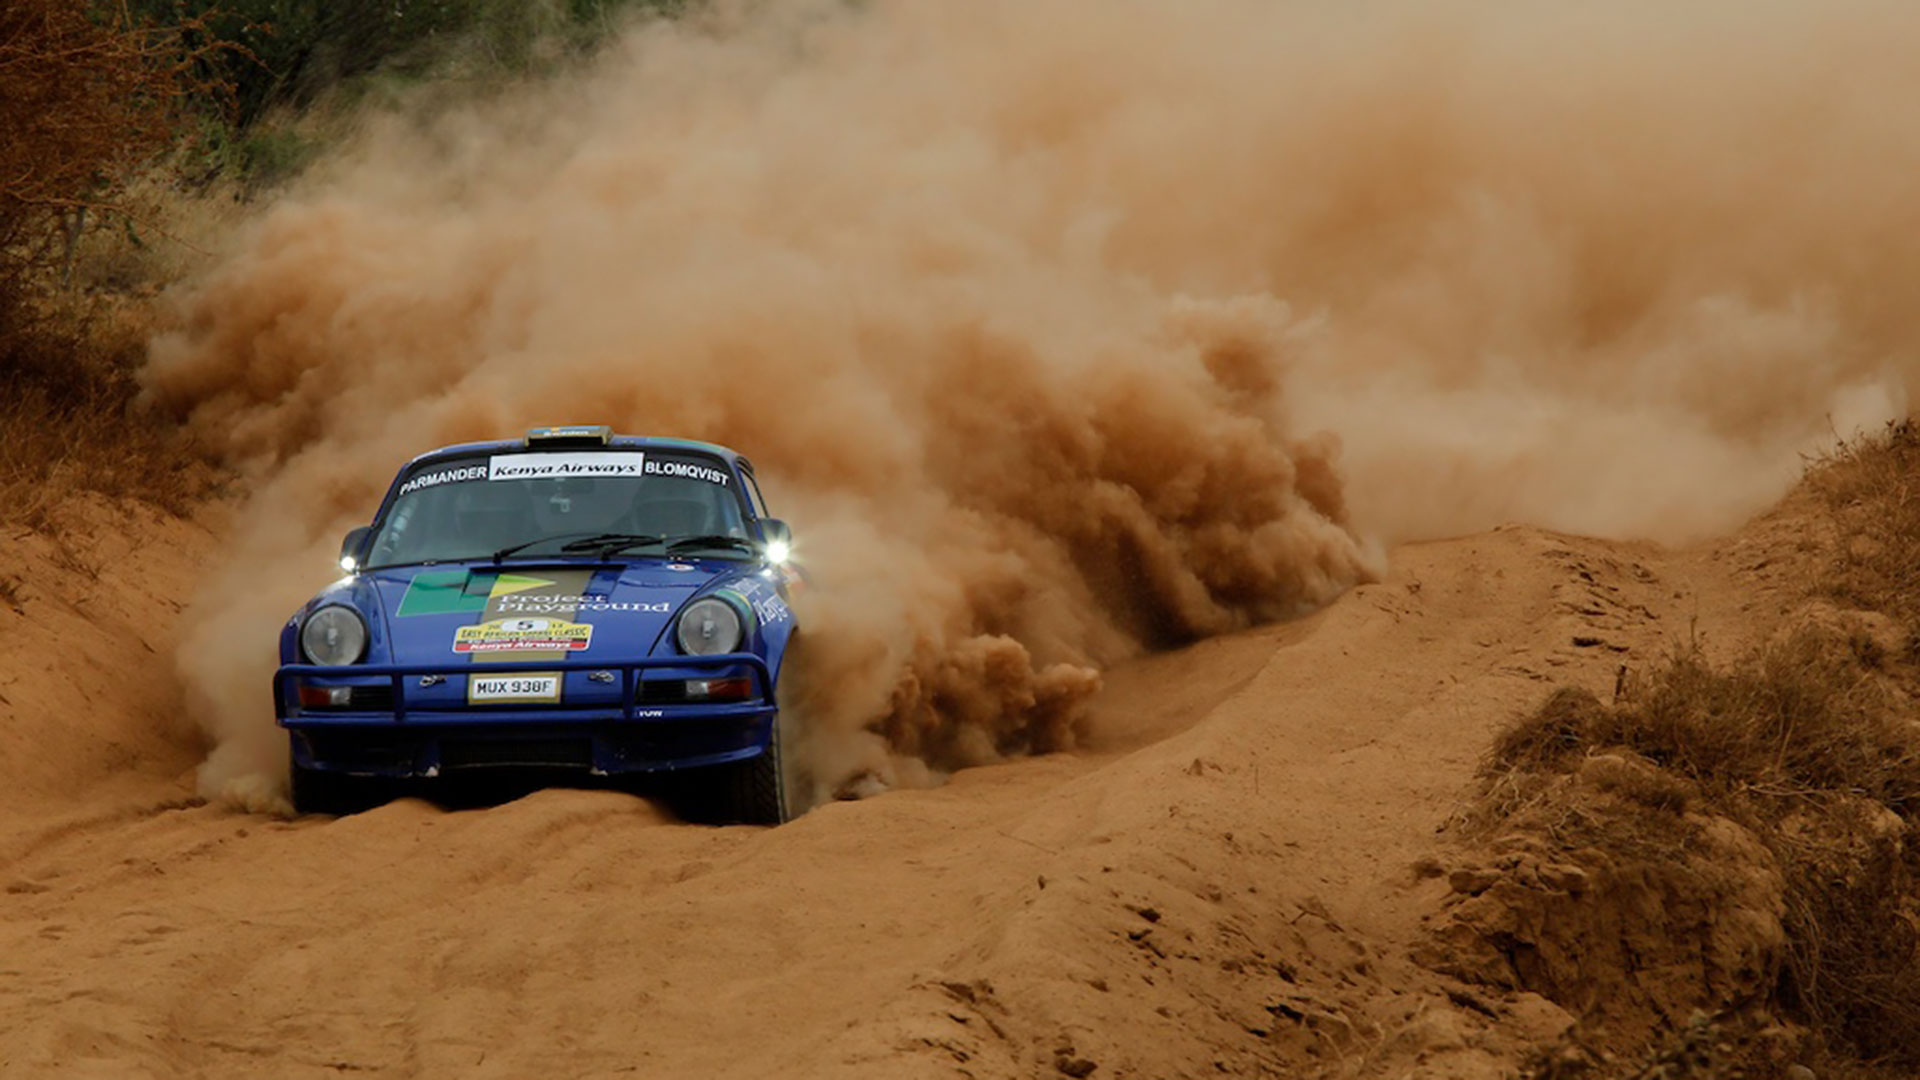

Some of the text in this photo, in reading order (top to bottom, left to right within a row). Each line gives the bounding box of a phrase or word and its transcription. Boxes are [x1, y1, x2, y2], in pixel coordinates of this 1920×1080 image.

[495, 463, 637, 476] Kenya Airways
[644, 461, 729, 486] BLOMQVIST
[399, 466, 487, 496] PARMANDER
[500, 594, 607, 604] Project
[496, 602, 671, 613] Playground
[517, 620, 534, 631] 5
[470, 642, 571, 651] Kenya Airways
[477, 680, 552, 694] MUX 938F
